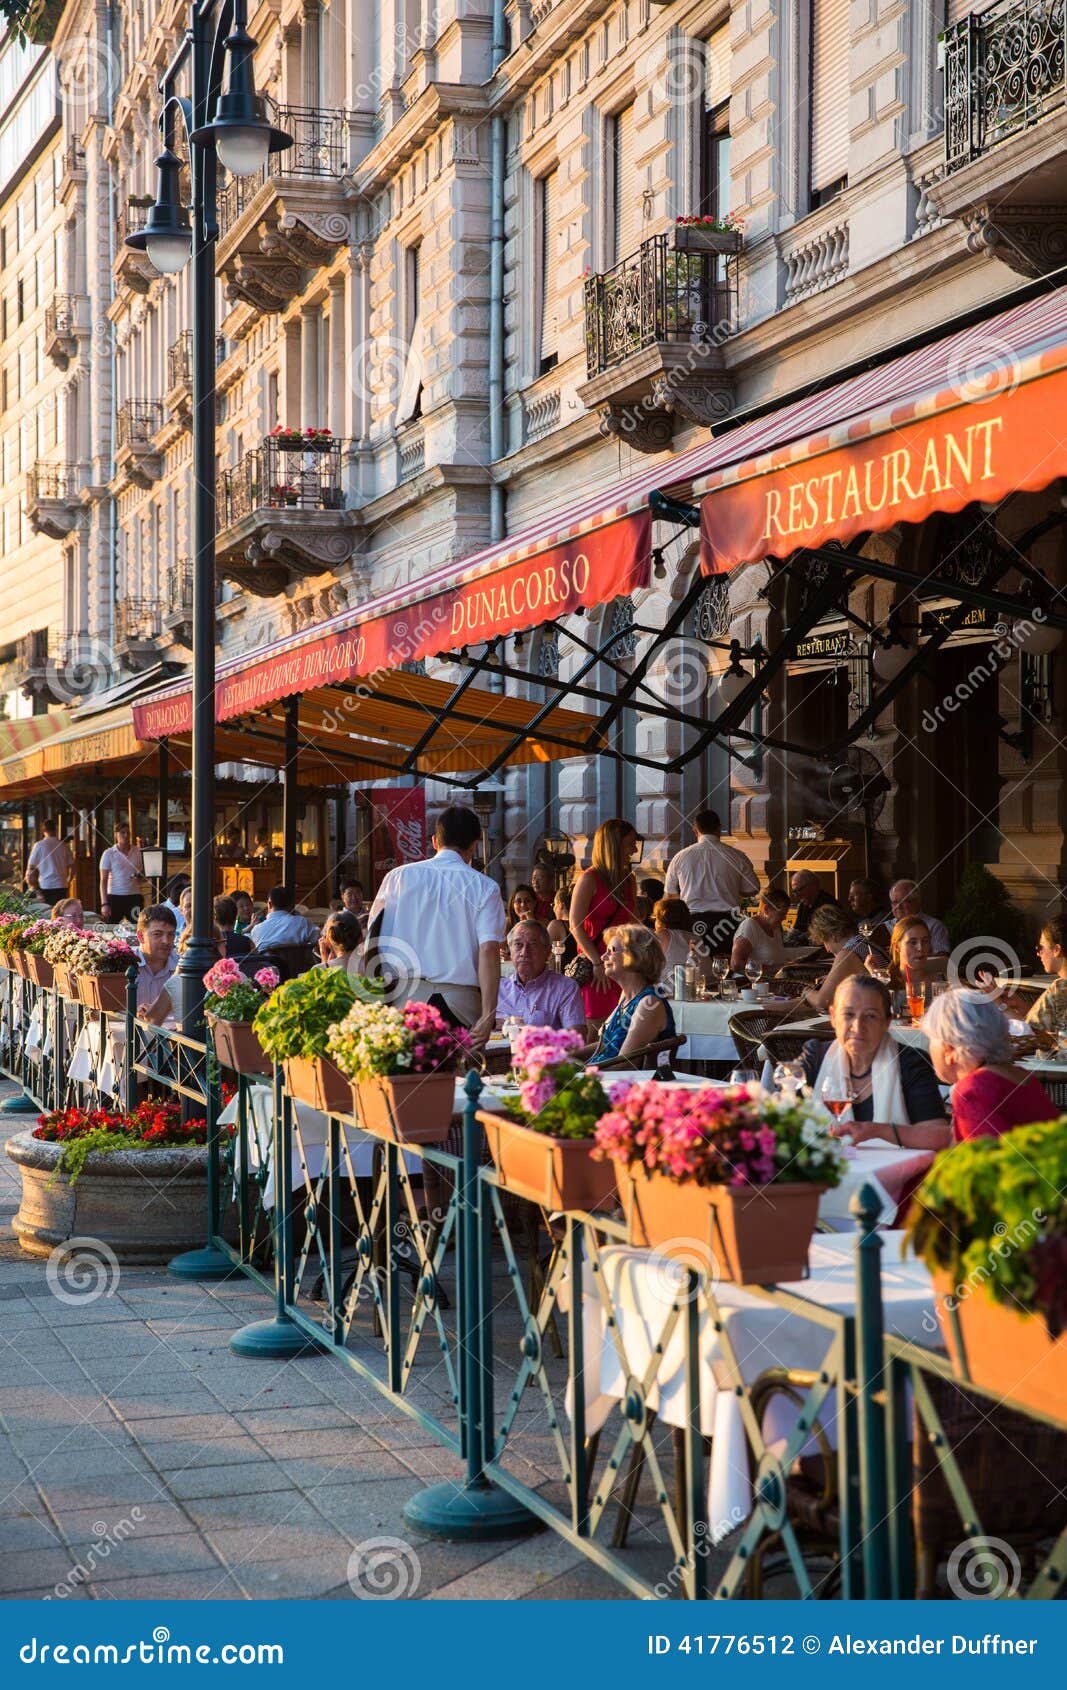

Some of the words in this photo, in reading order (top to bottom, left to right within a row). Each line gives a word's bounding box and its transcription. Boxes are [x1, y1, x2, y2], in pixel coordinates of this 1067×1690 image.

[762, 417, 1003, 540] RESTAURANT
[450, 554, 591, 636] DUNACORSO
[302, 637, 365, 680] DUNACORSO
[796, 634, 848, 657] RESTAURANT
[146, 702, 189, 730] DUNACORSO
